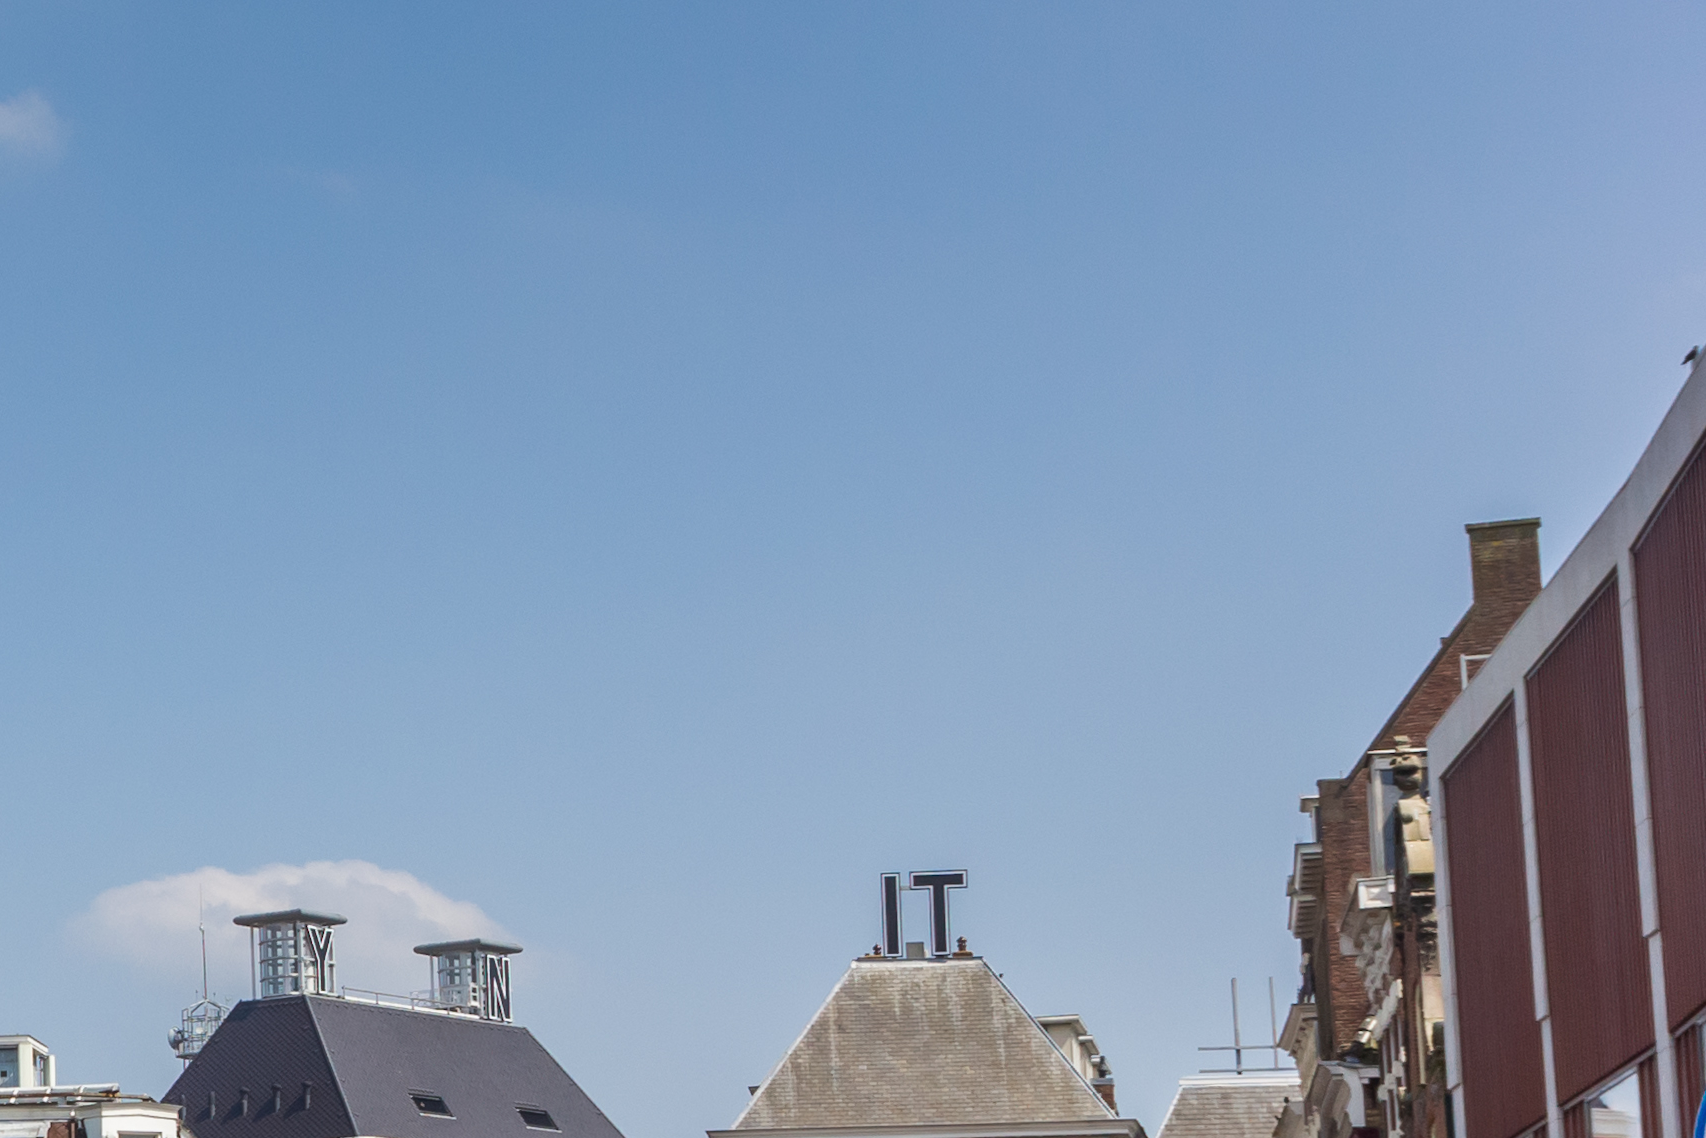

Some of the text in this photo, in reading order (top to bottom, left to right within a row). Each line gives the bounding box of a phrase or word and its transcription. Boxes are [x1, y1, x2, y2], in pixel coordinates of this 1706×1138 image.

[880, 869, 968, 957] IT
[306, 924, 334, 994] Y
[486, 954, 513, 1022] N
